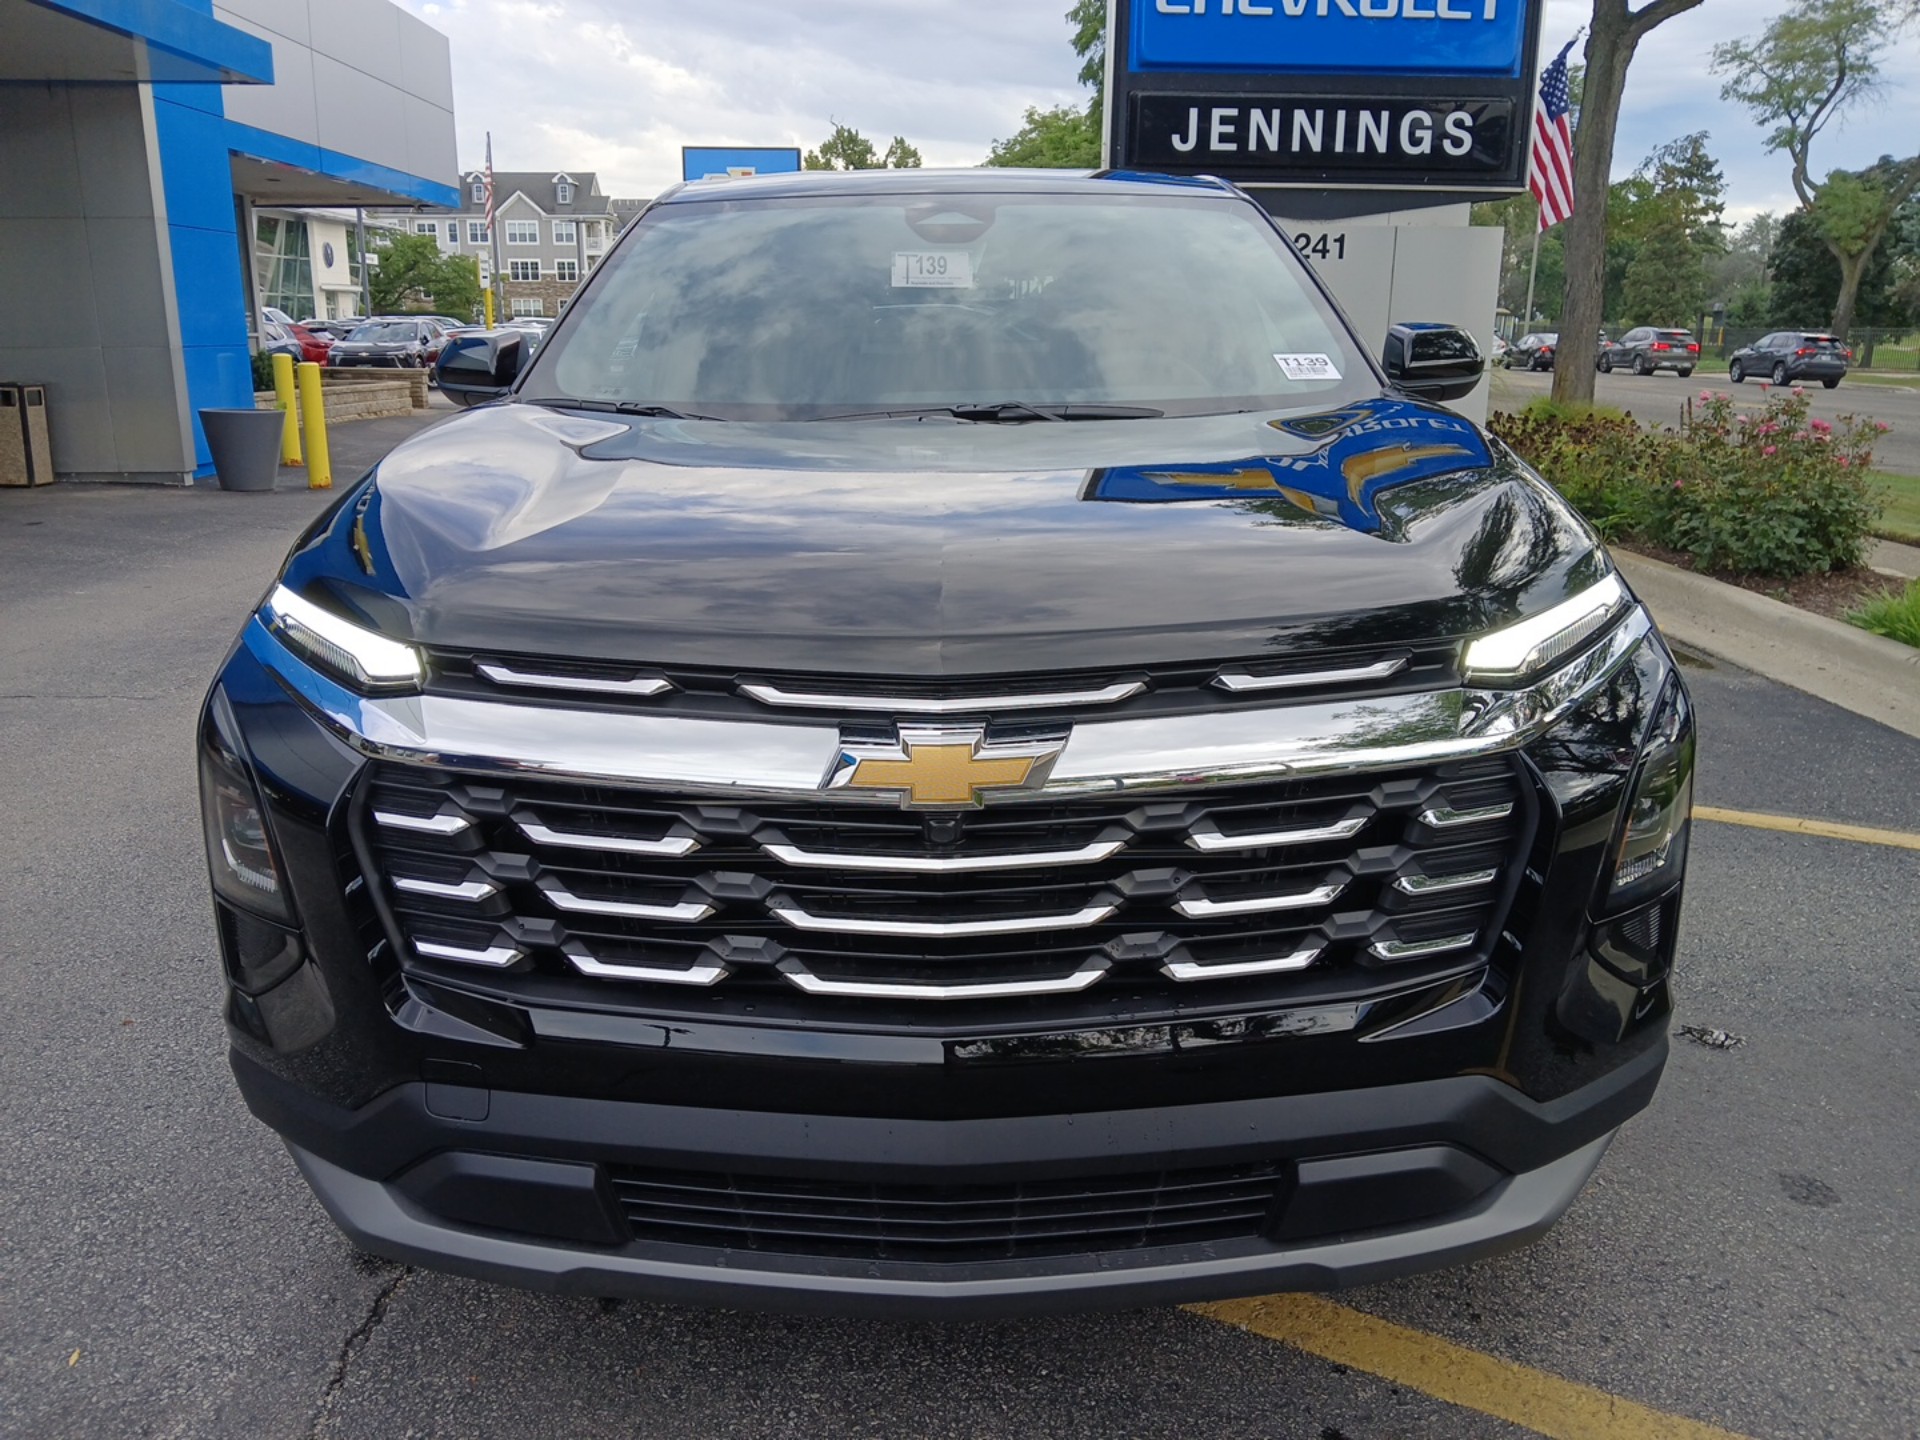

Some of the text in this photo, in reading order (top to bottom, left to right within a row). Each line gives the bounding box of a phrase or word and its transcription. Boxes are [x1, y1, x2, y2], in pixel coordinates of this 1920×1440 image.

[1171, 107, 1474, 156] JENNINGS
[1294, 232, 1346, 260] 241
[1279, 356, 1329, 367] T139
